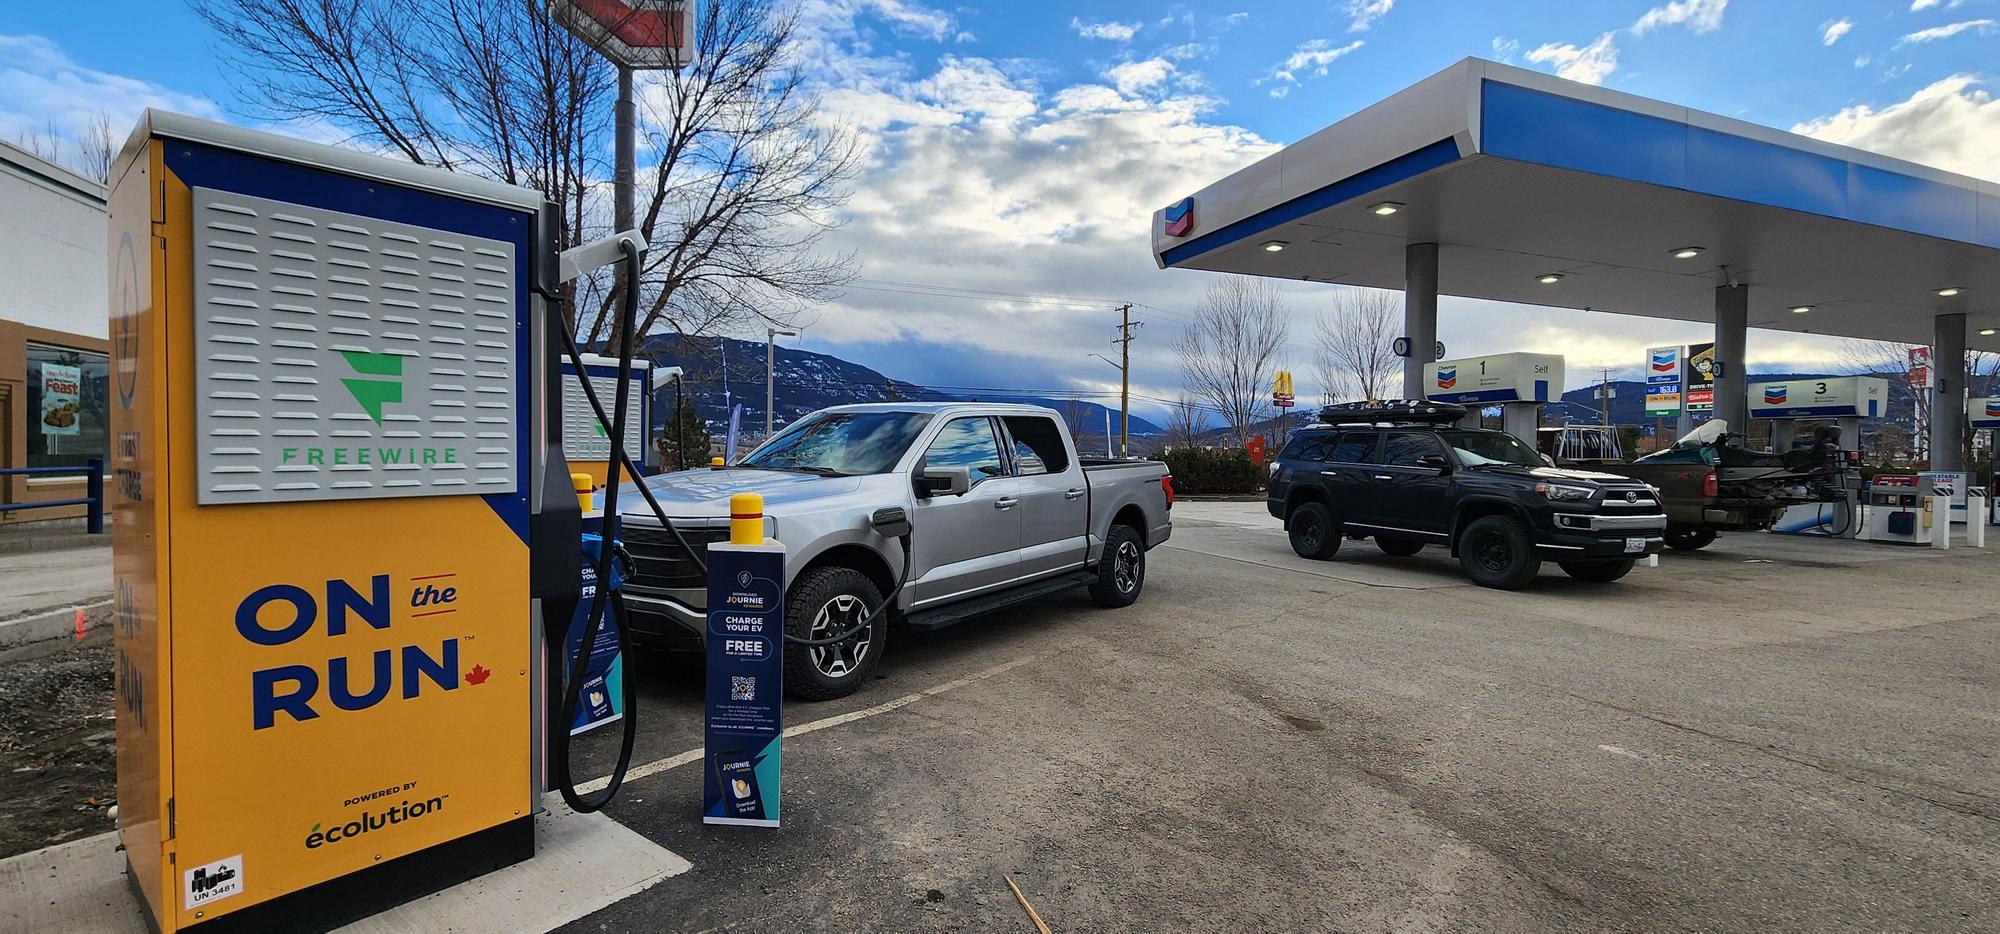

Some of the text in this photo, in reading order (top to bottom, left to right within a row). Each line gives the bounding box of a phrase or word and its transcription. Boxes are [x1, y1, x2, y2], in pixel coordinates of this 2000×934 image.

[1480, 360, 1486, 375] 1
[1534, 364, 1549, 374] Self
[46, 378, 79, 396] Feast
[1815, 382, 1827, 394] 3
[282, 447, 458, 466] FREEWIRE
[582, 585, 597, 596] FR
[726, 596, 764, 604] JOURNIE
[234, 573, 458, 647] ON the
[725, 616, 763, 625] CHARGE
[726, 624, 763, 633] YOUR EV
[725, 639, 763, 652] FREE
[722, 760, 751, 771] JOURNIE
[343, 780, 418, 807] POWERED BY
[194, 883, 236, 901] UN 3481
